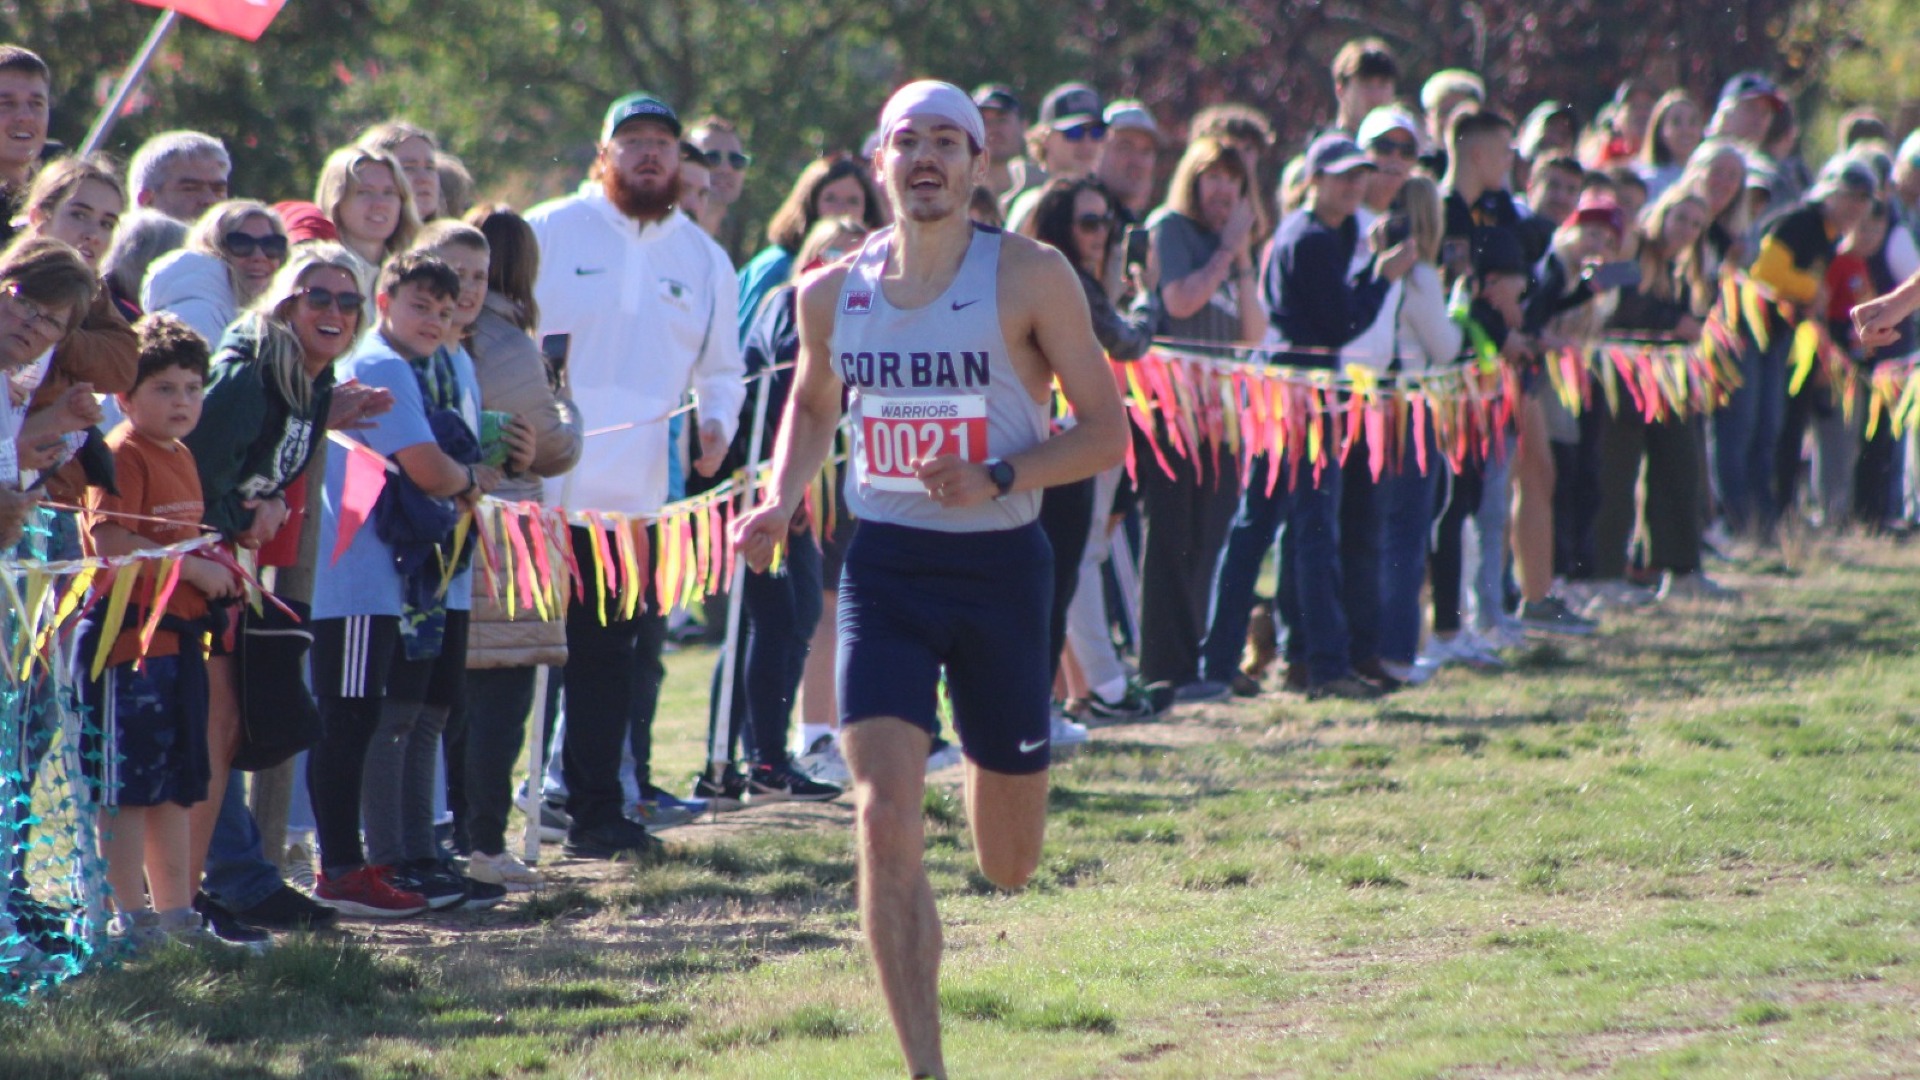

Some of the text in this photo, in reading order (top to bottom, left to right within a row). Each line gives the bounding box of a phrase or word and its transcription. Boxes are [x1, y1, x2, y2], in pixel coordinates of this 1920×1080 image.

[841, 351, 990, 388] CORBAN
[881, 404, 958, 418] WARRIORS
[873, 421, 969, 474] 0021
